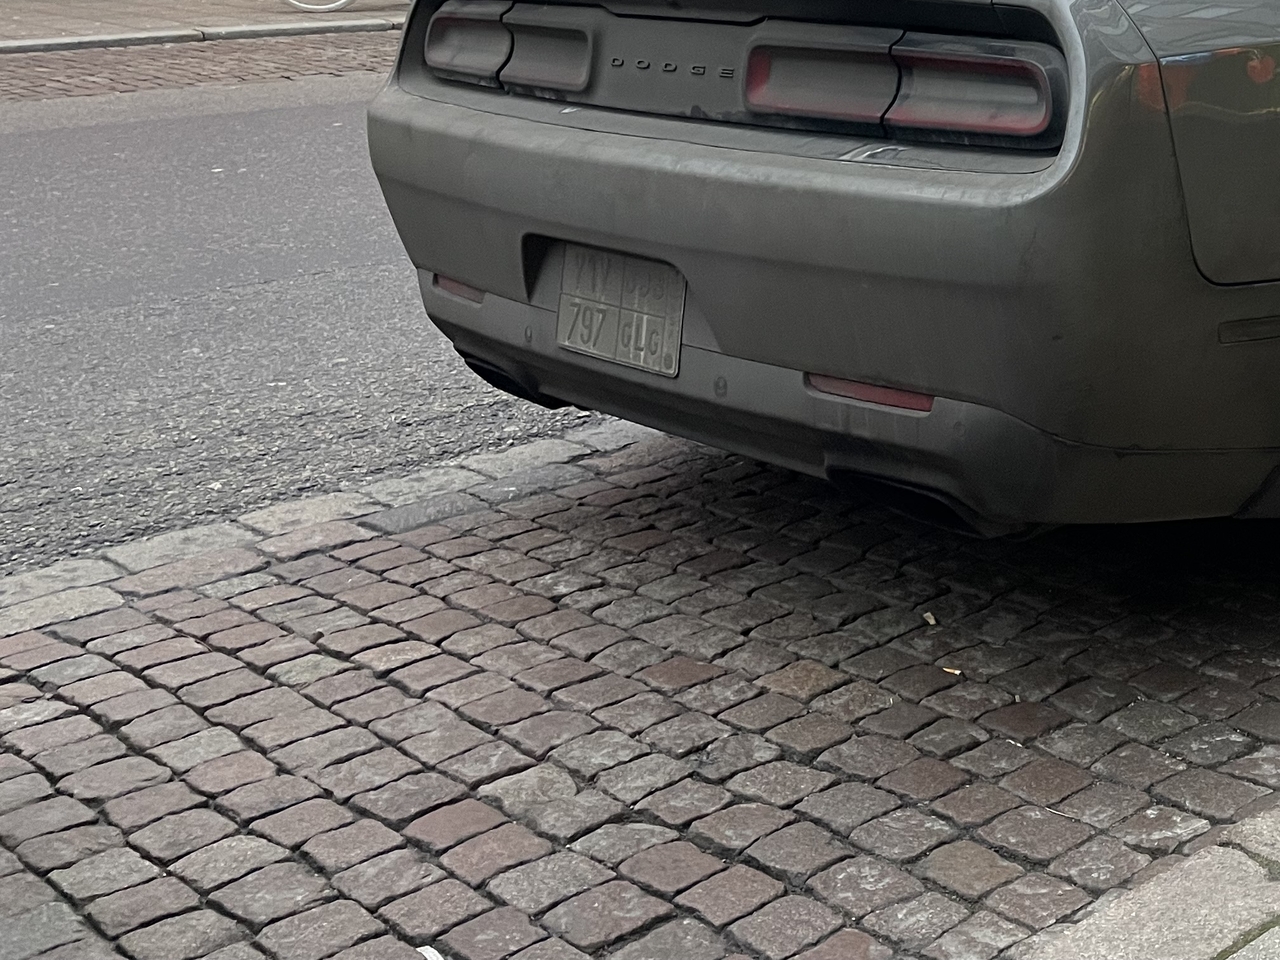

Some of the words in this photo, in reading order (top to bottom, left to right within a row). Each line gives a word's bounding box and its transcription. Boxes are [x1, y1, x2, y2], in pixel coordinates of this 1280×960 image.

[610, 58, 735, 79] DODGE
[567, 301, 607, 349] 797
[621, 321, 660, 356] GLG
